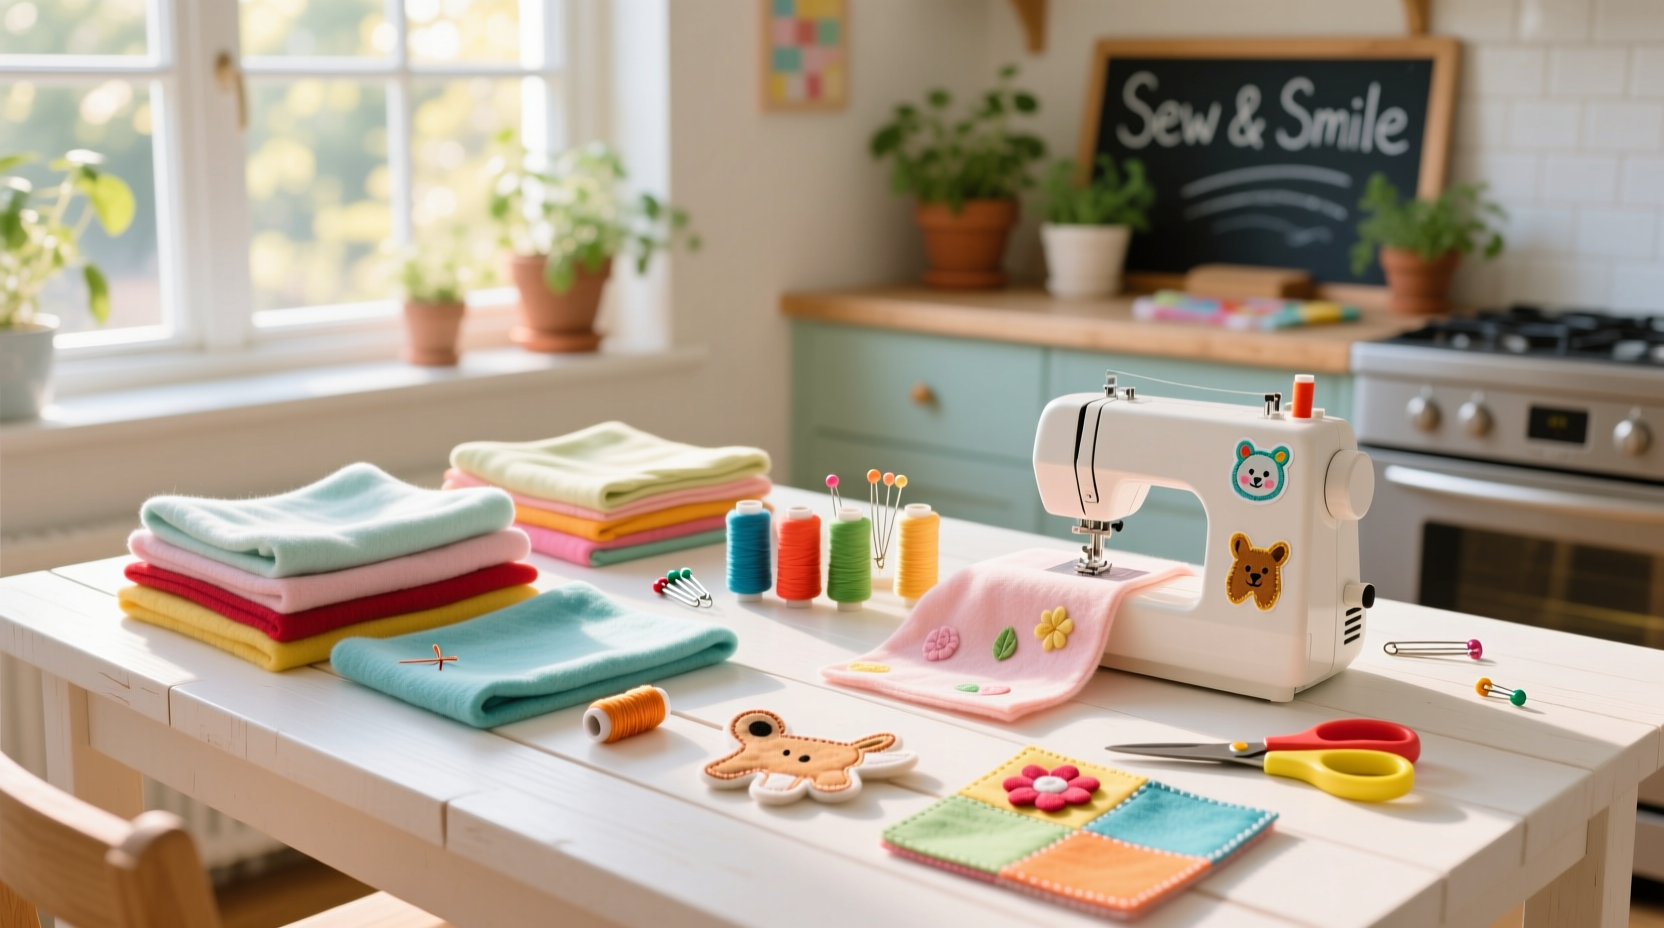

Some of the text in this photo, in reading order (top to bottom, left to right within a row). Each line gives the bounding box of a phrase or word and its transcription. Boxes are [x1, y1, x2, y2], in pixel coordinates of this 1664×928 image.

[1117, 71, 1409, 155] Sew & Smile
